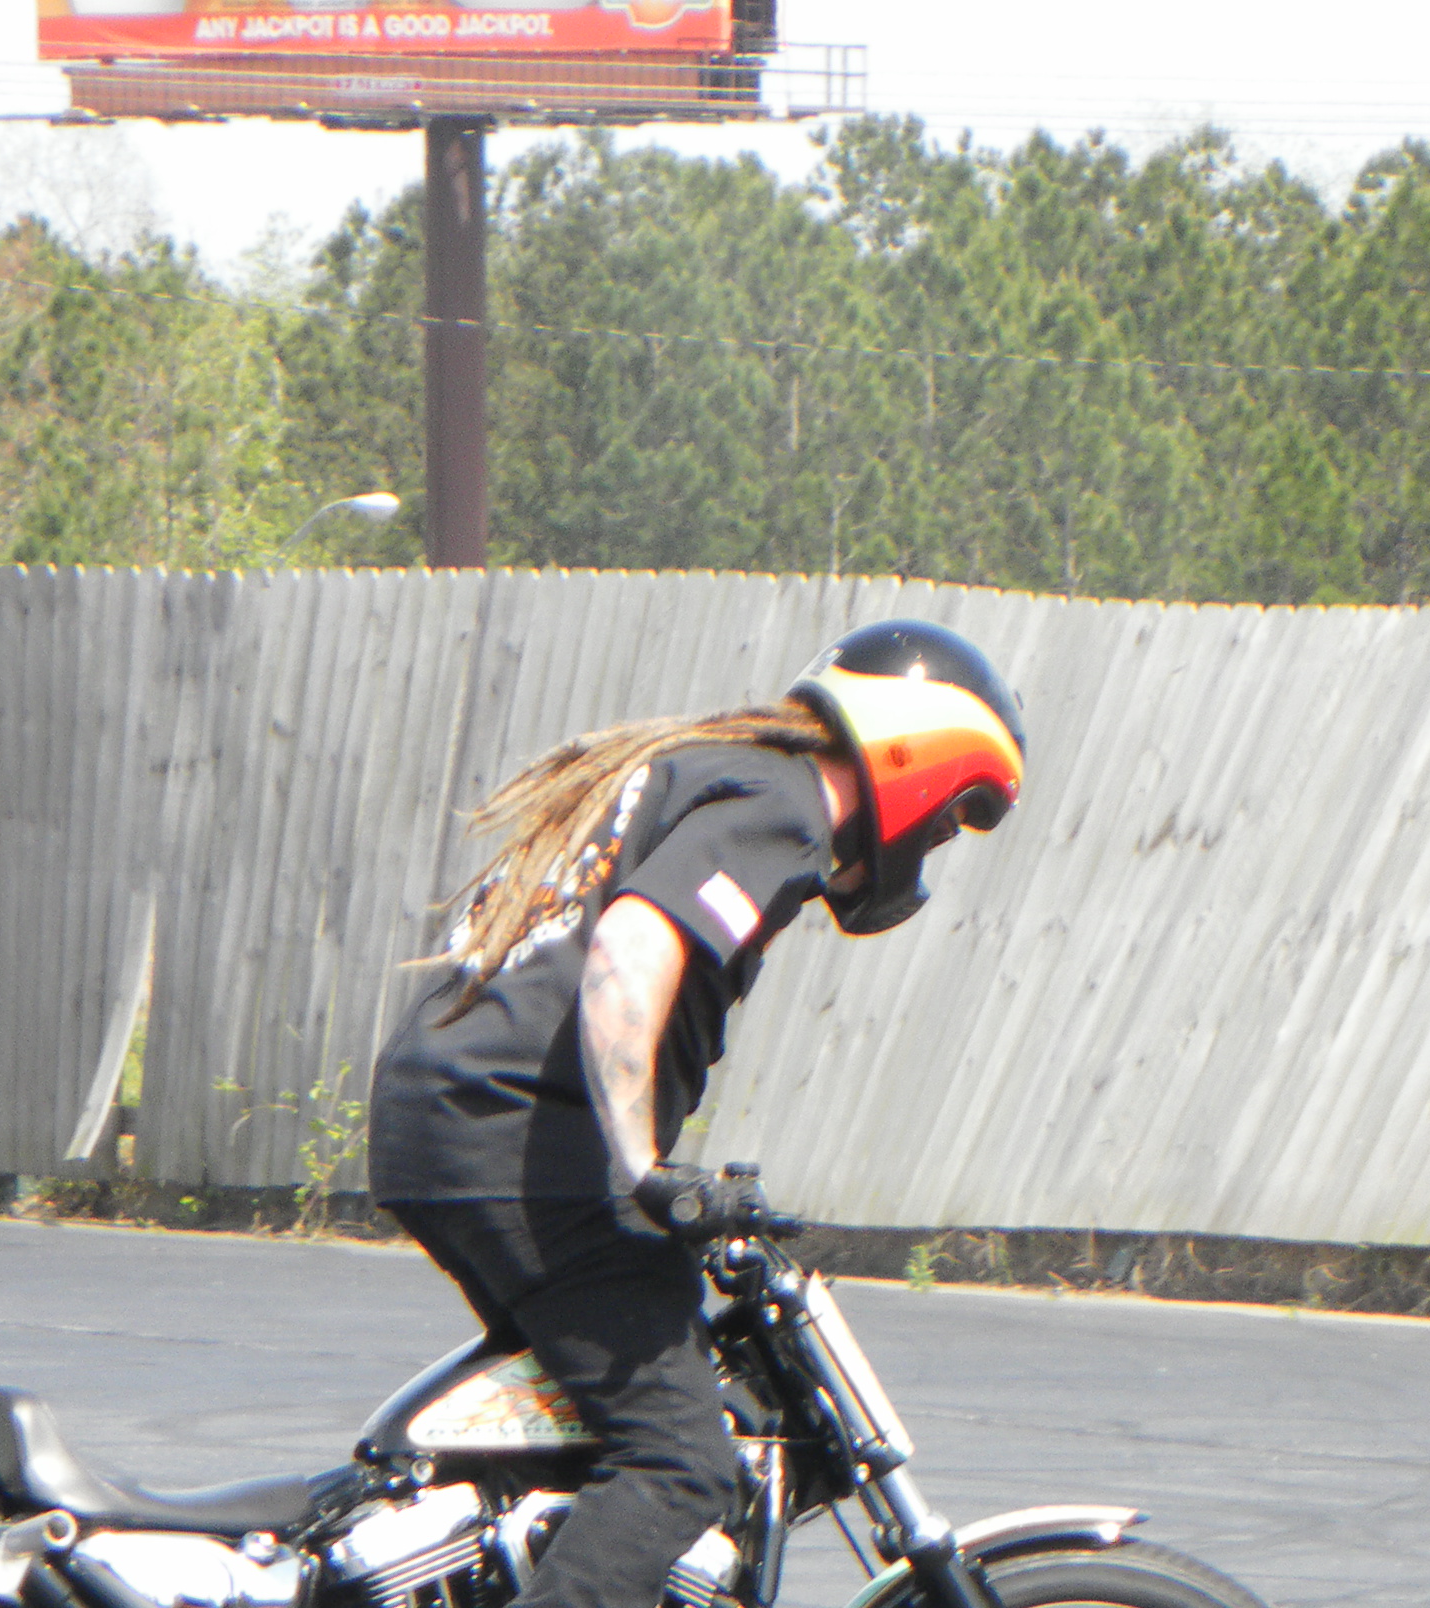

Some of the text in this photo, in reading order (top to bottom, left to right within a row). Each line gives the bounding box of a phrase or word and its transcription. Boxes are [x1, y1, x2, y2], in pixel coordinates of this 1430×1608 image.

[196, 17, 238, 38] ANY
[241, 16, 334, 38] JACKPOT
[338, 15, 359, 37] IS
[361, 14, 380, 37] A
[384, 14, 451, 36] GOOD
